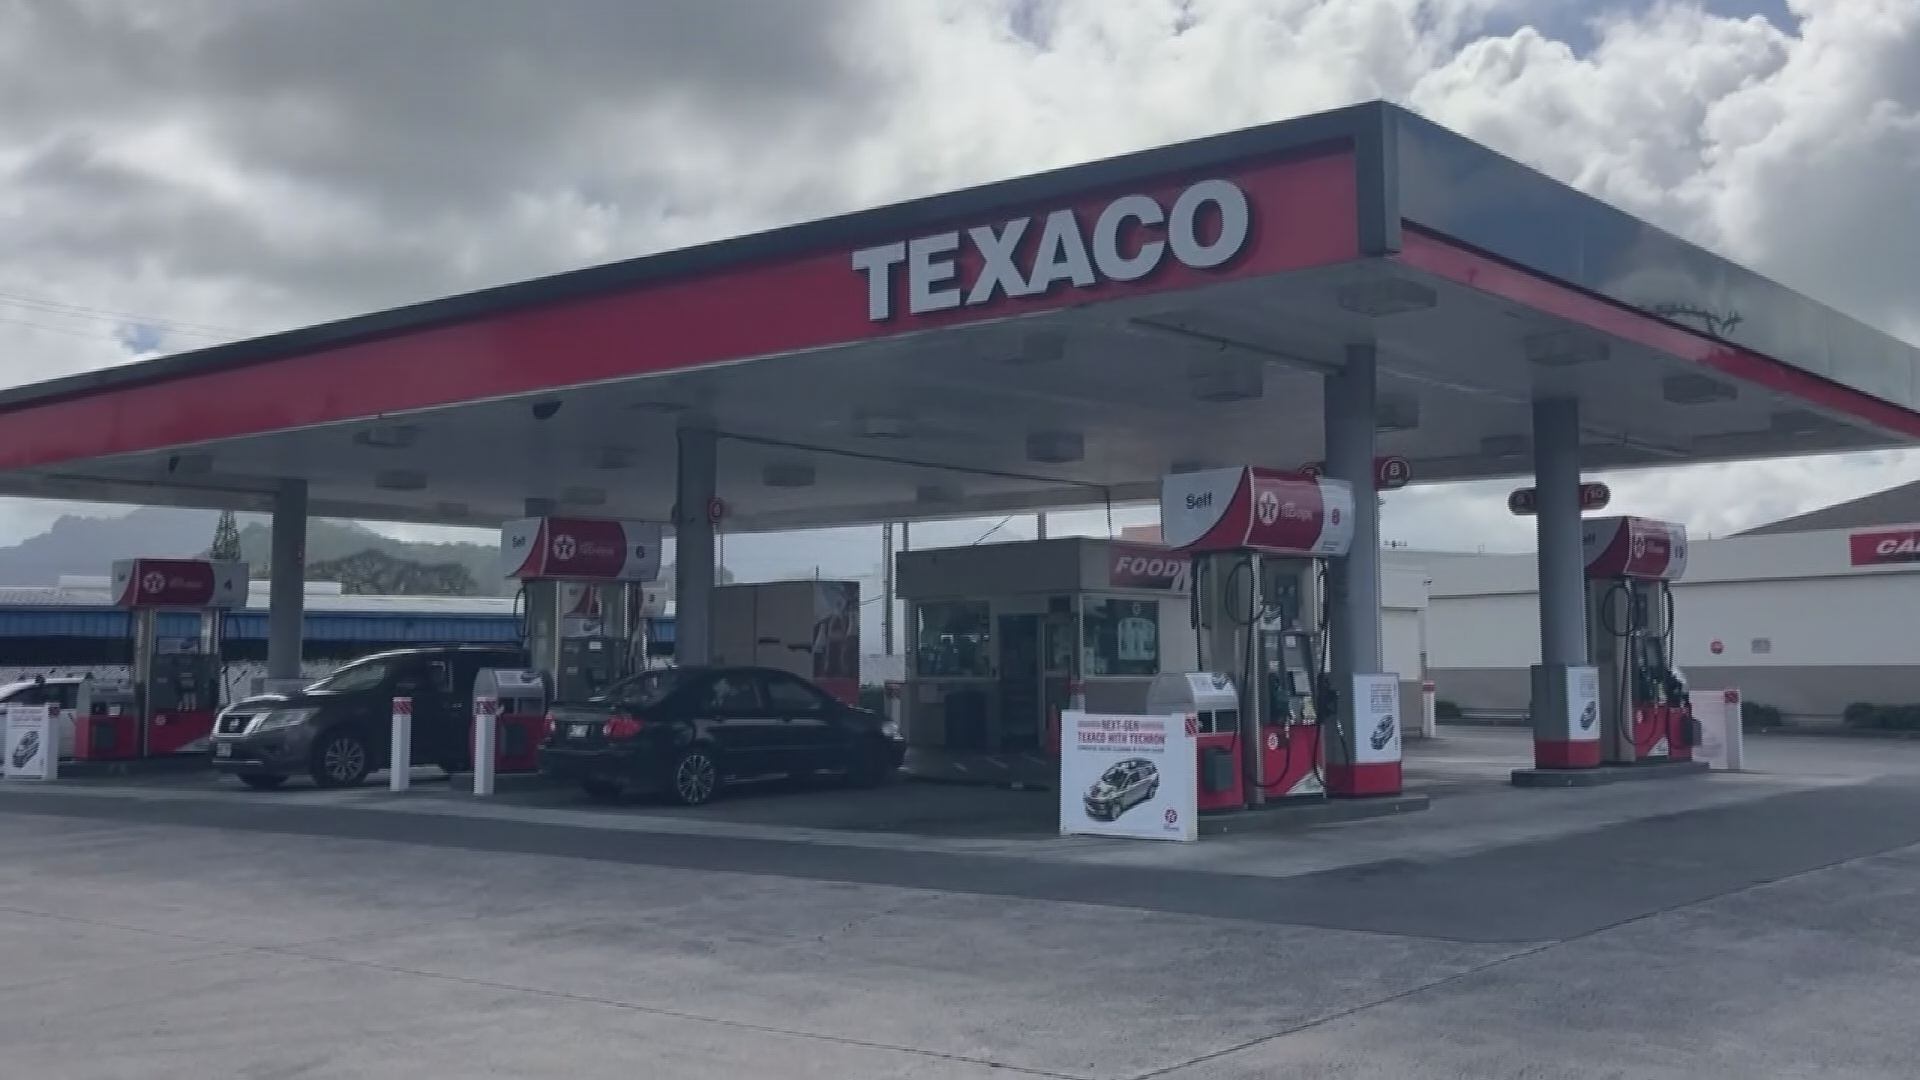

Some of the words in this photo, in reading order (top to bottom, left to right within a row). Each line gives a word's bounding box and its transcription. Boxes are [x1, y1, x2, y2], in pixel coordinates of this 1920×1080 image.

[851, 179, 1249, 322] TEXACO
[1186, 491, 1213, 510] Self
[512, 534, 526, 548] Self
[1115, 556, 1179, 577] FOOD
[1078, 731, 1106, 744] TEXACO
